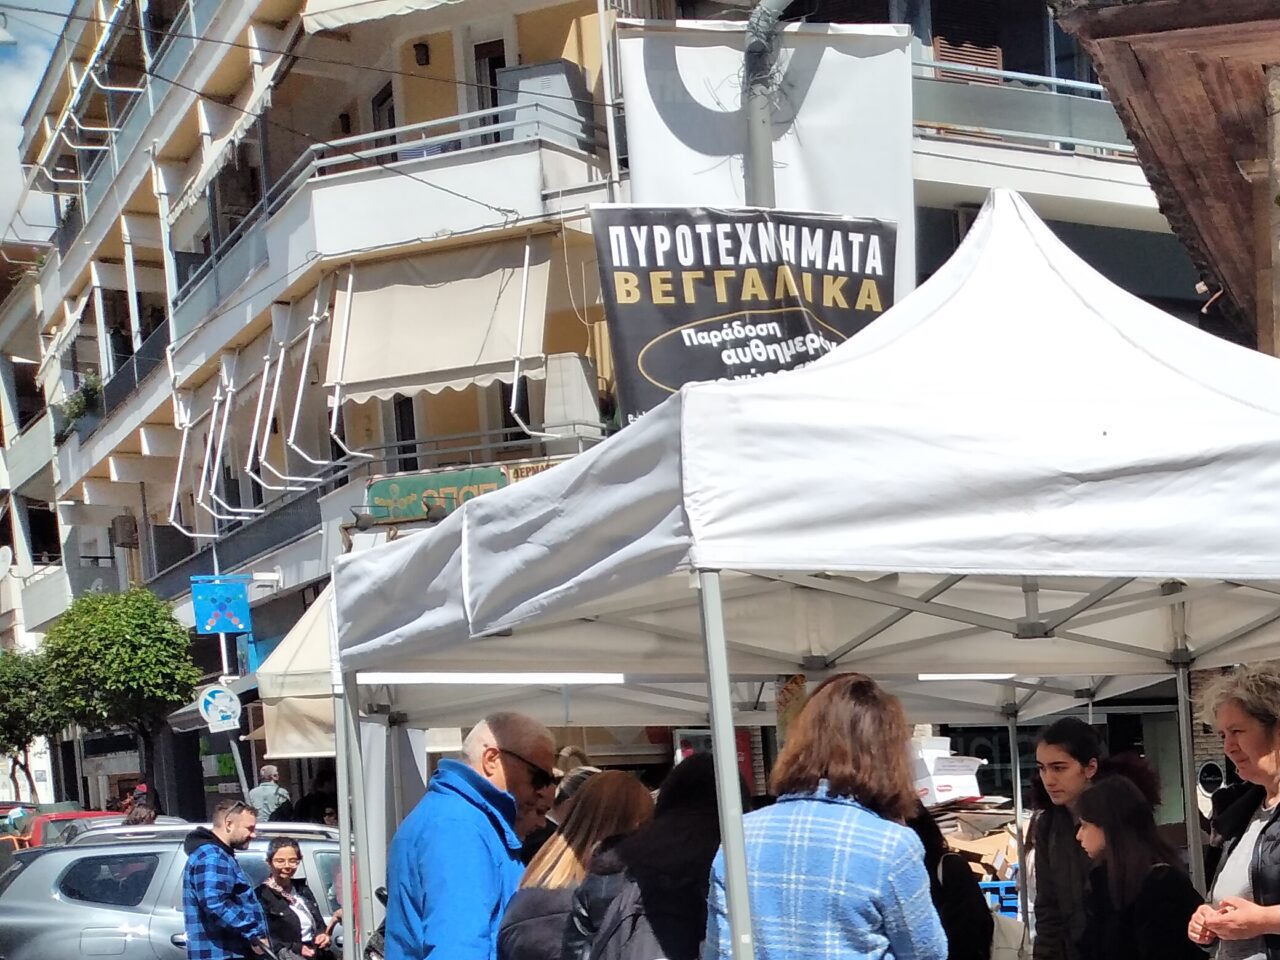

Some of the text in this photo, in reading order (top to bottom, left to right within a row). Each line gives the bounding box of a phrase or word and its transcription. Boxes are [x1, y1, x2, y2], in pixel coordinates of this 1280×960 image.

[607, 221, 884, 277] ΠΥΡΟΤΕΧΝΗΜΑΤΑ
[613, 266, 884, 313] ΒΕΓΓΑΛΙΚΑ
[681, 320, 781, 347] Παράδοση
